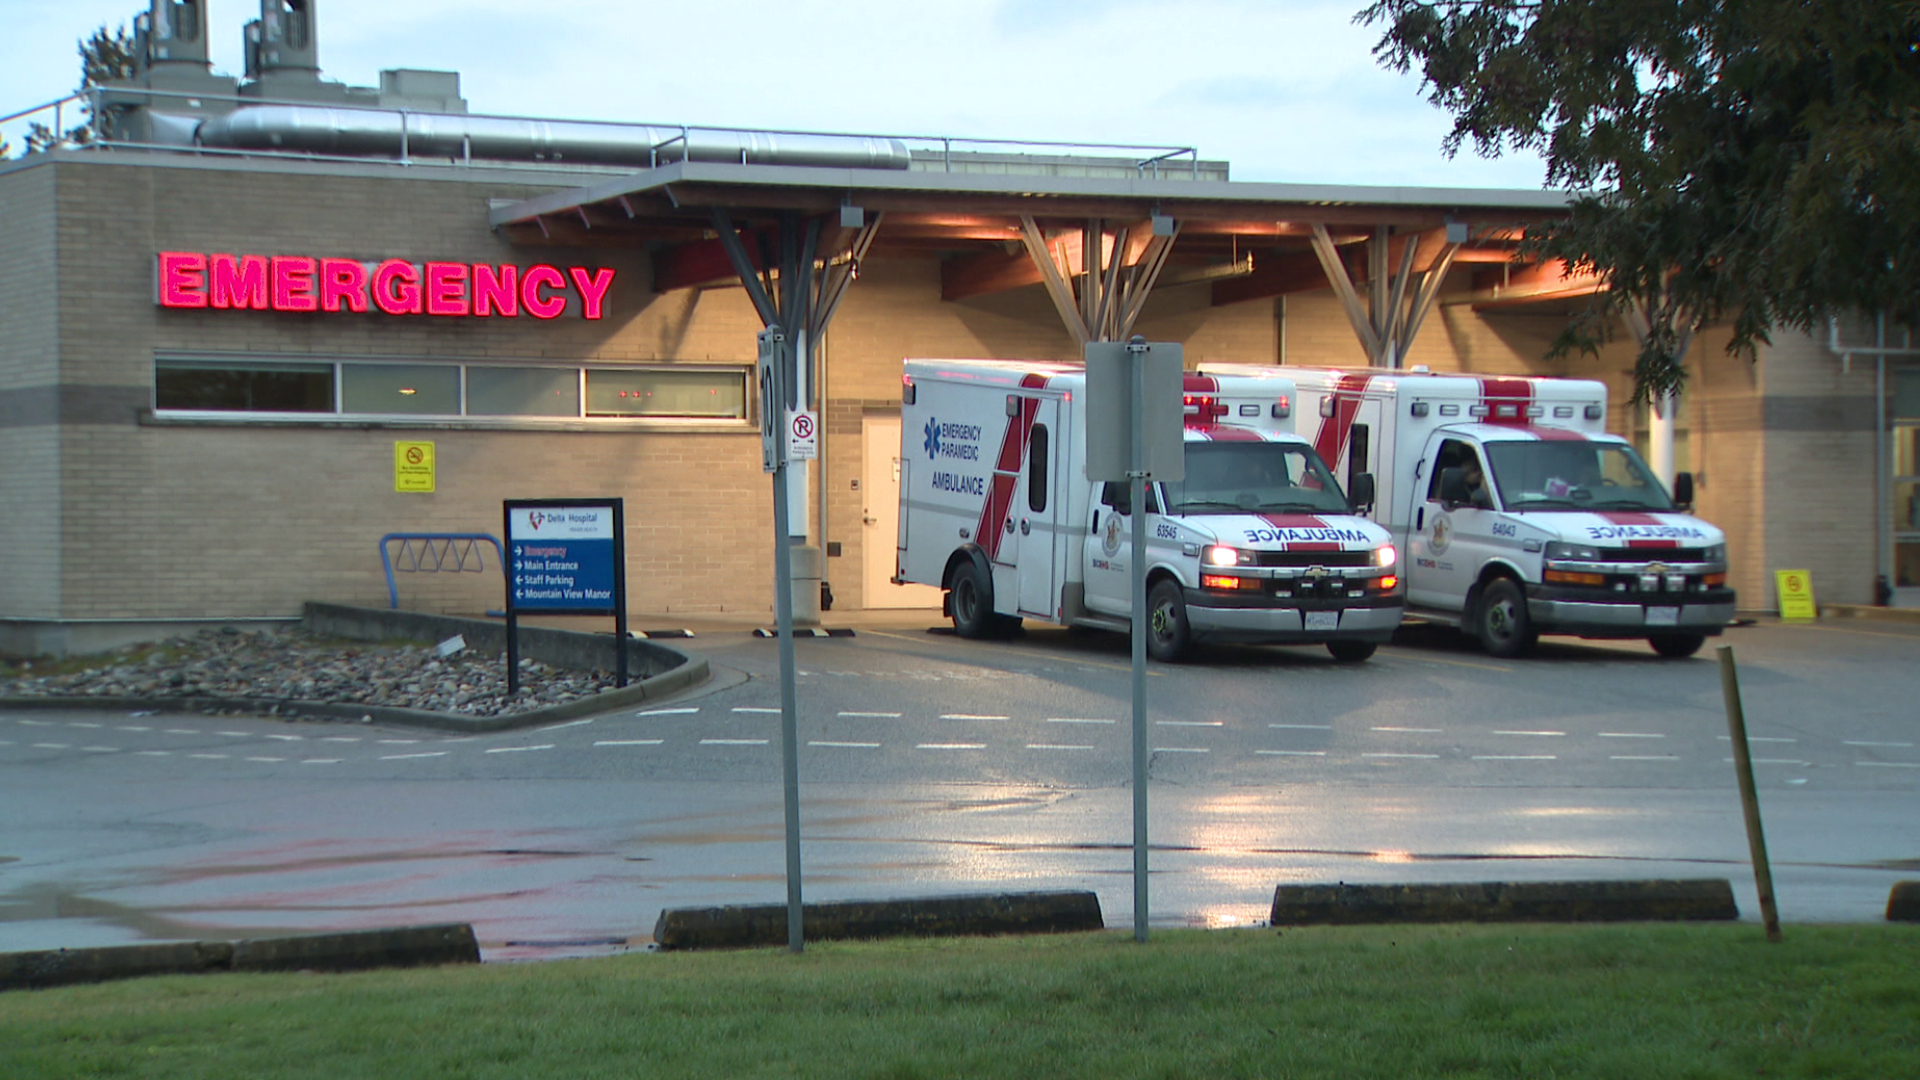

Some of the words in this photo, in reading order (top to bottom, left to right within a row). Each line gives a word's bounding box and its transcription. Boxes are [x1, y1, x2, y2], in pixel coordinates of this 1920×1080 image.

[158, 251, 616, 319] EMERGENCY
[942, 423, 981, 442] EMERGENCY
[941, 442, 979, 462] PARAMEDIC
[932, 471, 984, 496] AMBULANCE
[547, 513, 566, 522] Delta
[569, 513, 598, 524] Hospital
[1157, 524, 1177, 539] 63545
[1492, 523, 1516, 537] 64043
[525, 547, 567, 558] Emergency
[524, 560, 544, 570] Main
[545, 561, 579, 570] Entrance
[525, 575, 543, 584] Staff
[545, 575, 574, 587] Parking
[525, 588, 562, 598] Mountain
[563, 588, 583, 598] View
[584, 588, 611, 598] Manor
